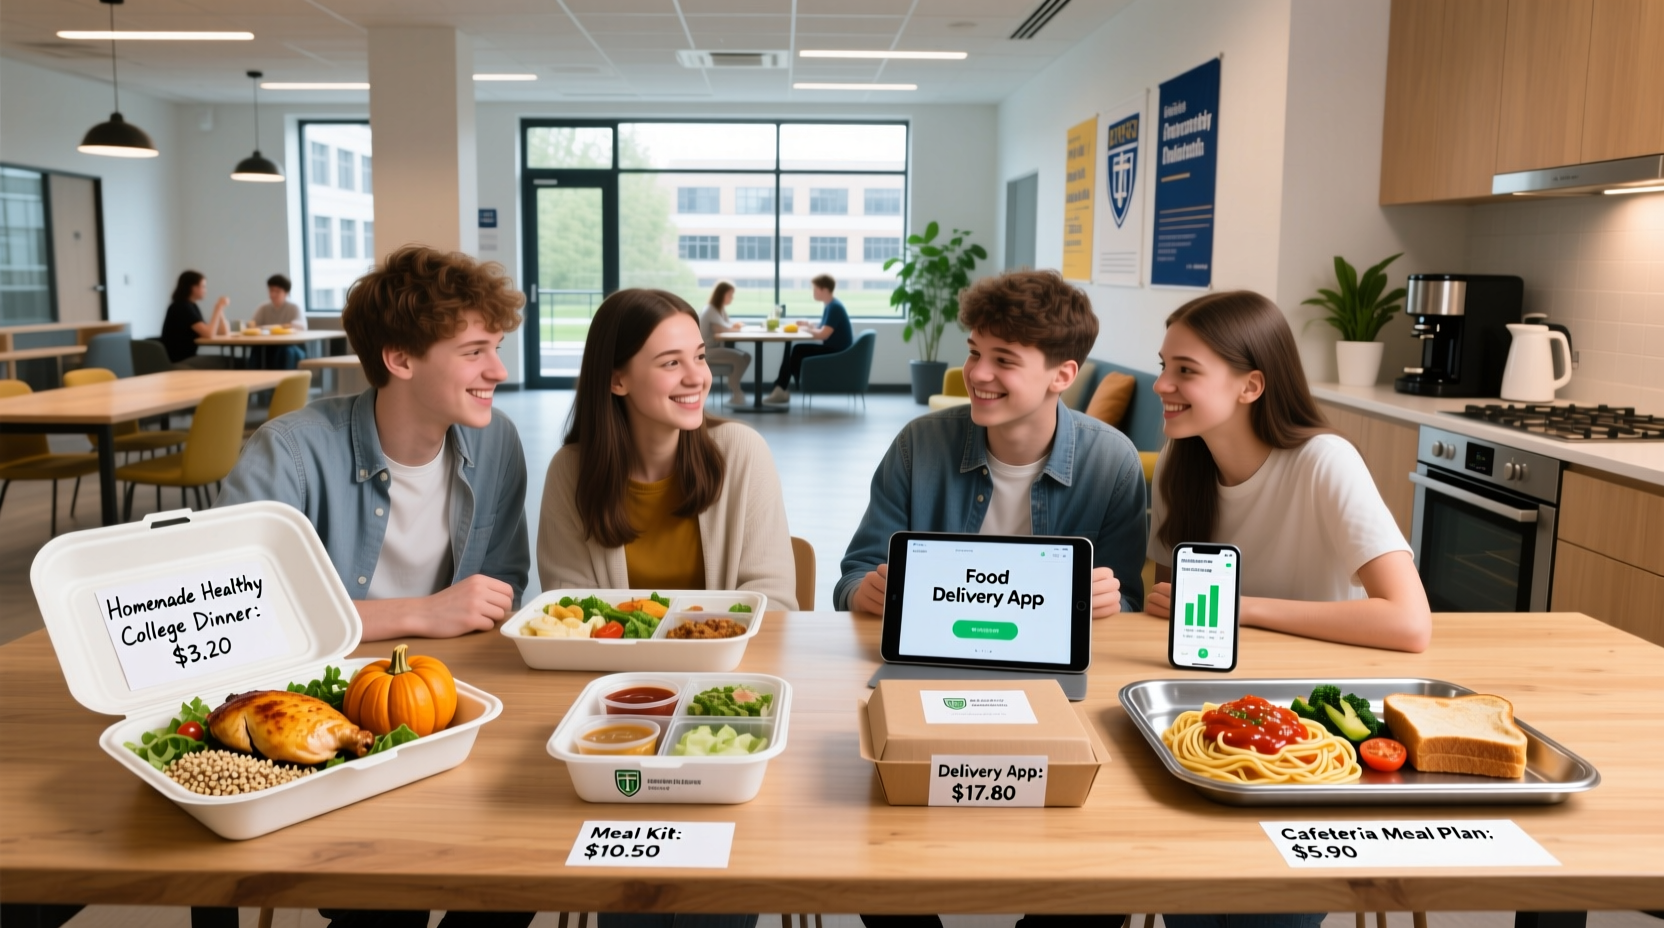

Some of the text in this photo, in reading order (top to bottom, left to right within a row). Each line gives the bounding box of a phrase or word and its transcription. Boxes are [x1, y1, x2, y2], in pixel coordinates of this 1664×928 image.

[200, 574, 263, 599] Healthy
[966, 568, 1010, 585] Food
[932, 586, 1045, 610] Delivery App
[121, 605, 262, 646] College Dinner:
[172, 636, 232, 669] $3.20
[938, 763, 1043, 783] Delivery App:
[951, 782, 1017, 803] $17.80
[590, 826, 682, 841] Meal Kit:
[1280, 825, 1495, 841] Cafeteria Meal Plan:
[584, 842, 661, 861] $10.50
[1291, 843, 1358, 862] $5.90
